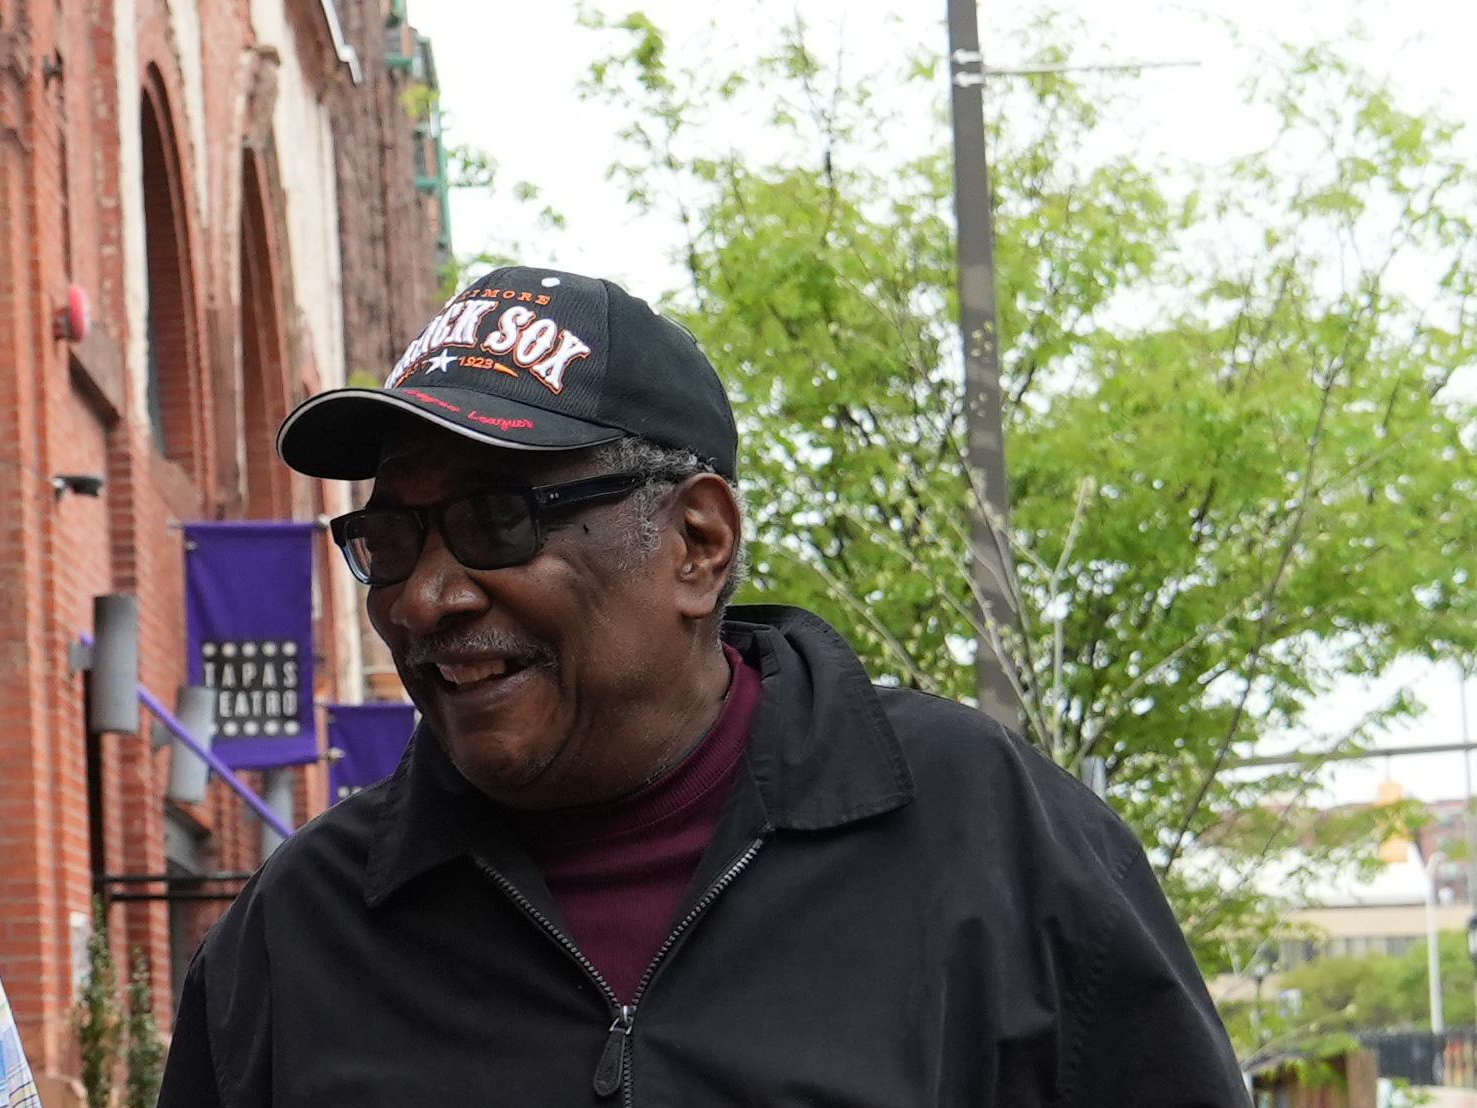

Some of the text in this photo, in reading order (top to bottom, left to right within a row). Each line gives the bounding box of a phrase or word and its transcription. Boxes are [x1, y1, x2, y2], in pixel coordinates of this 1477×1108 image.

[458, 356, 494, 369] 1923
[480, 305, 591, 395] SOX
[203, 660, 298, 689] TAPAS
[219, 689, 298, 718] EATRO
